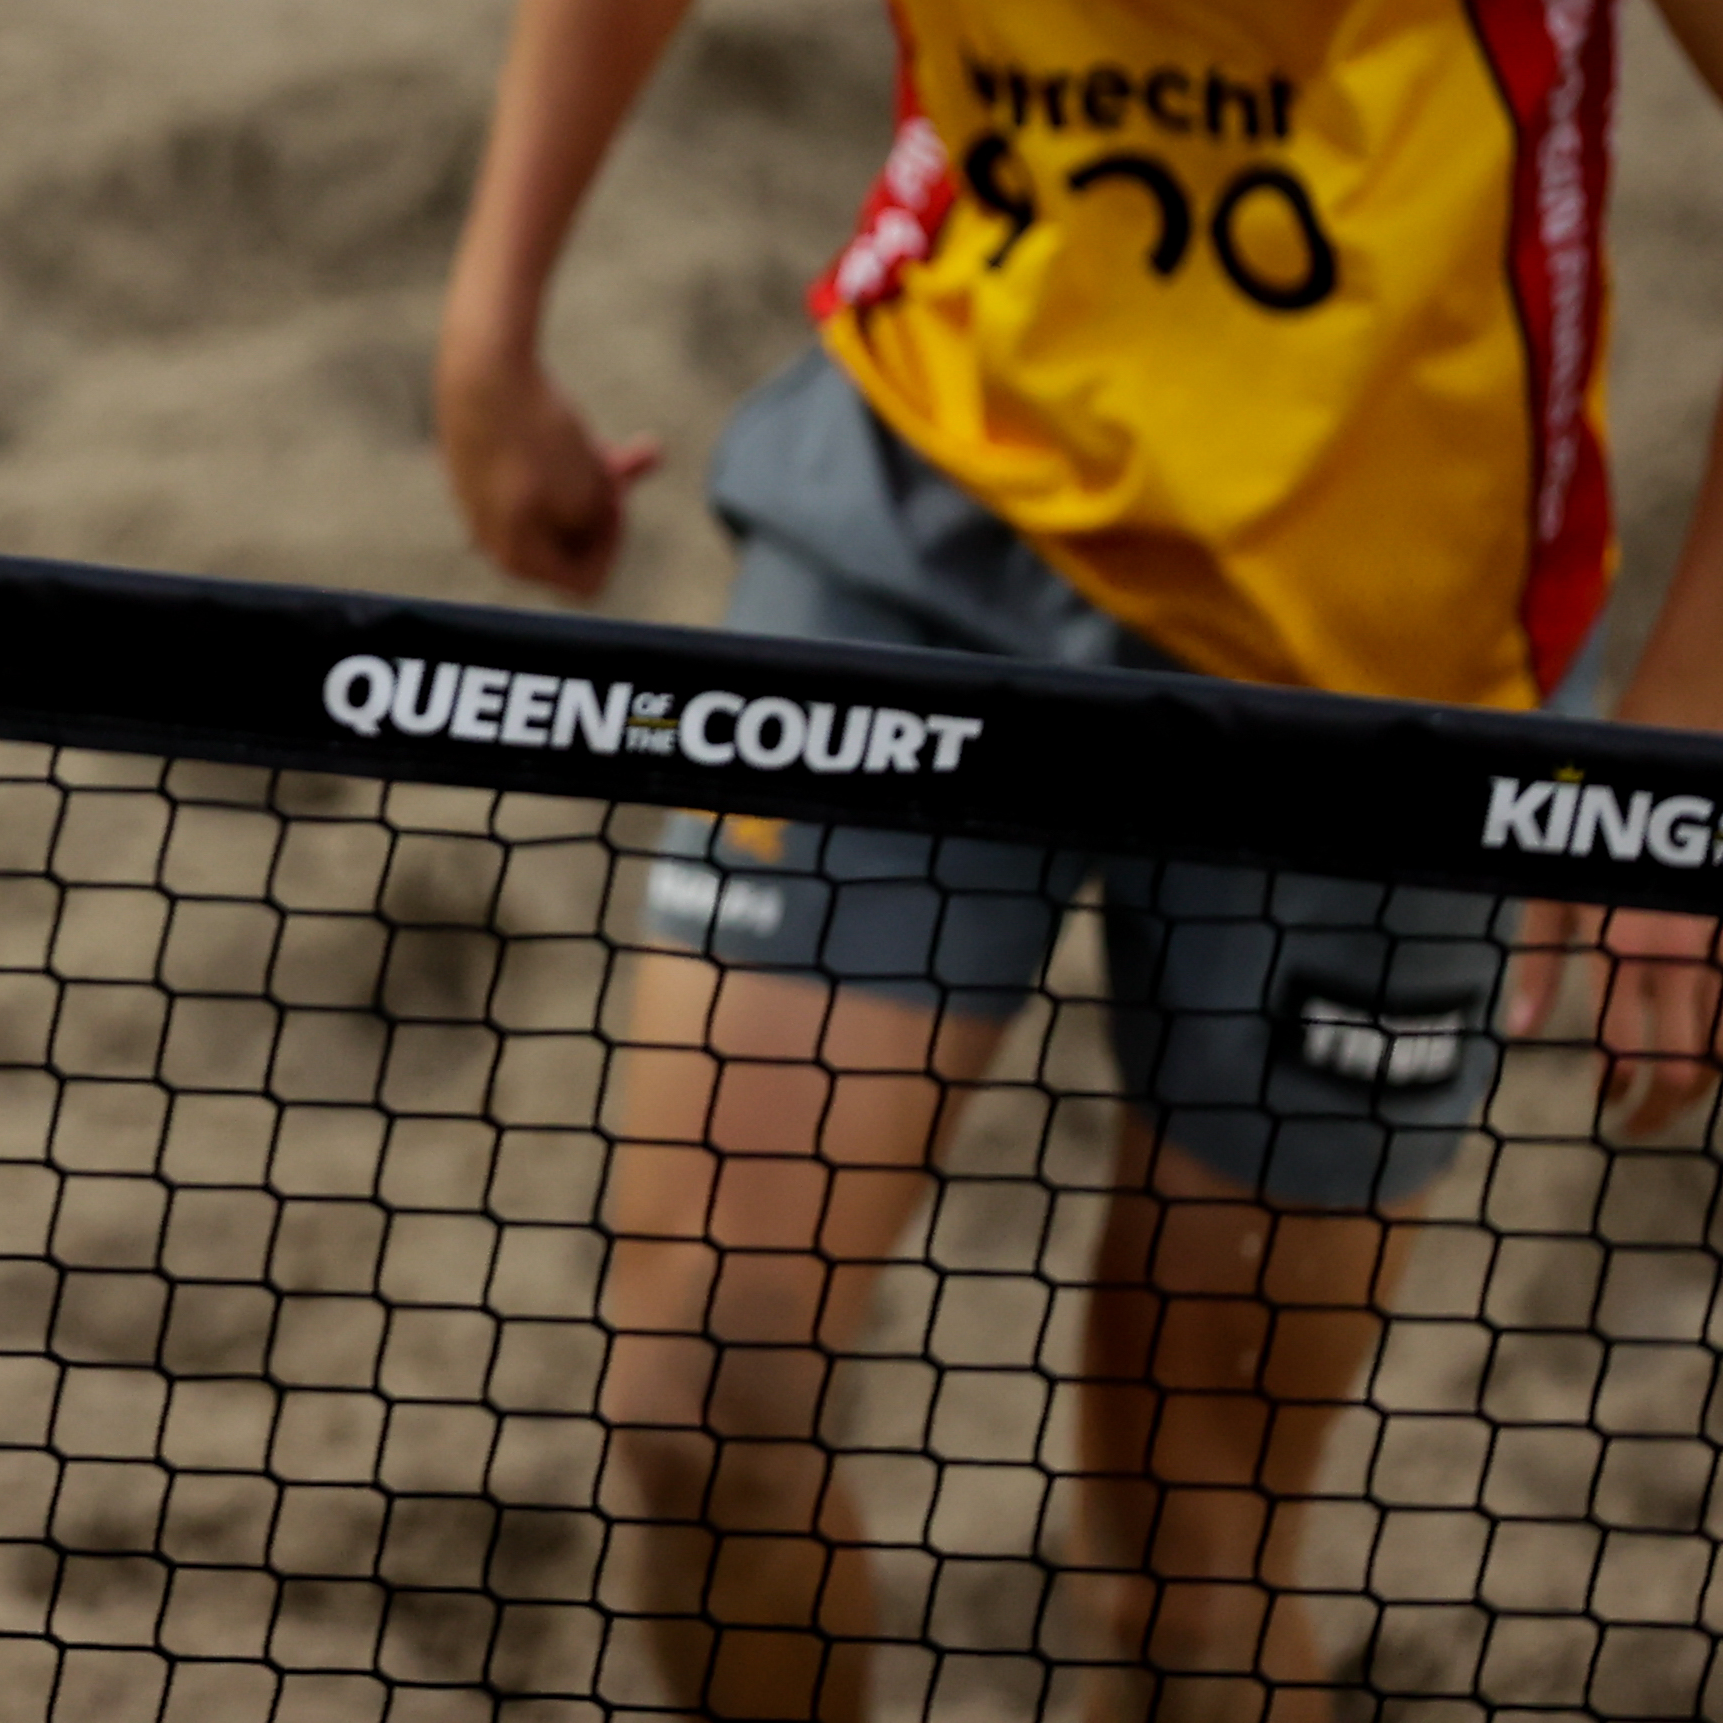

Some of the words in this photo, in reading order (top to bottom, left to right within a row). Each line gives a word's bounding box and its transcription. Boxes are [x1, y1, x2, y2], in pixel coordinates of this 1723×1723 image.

[322, 654, 633, 754] QUEEN
[625, 726, 676, 755] THE
[632, 691, 675, 718] OF
[677, 689, 983, 774] COURT
[1480, 774, 1715, 869] KING
